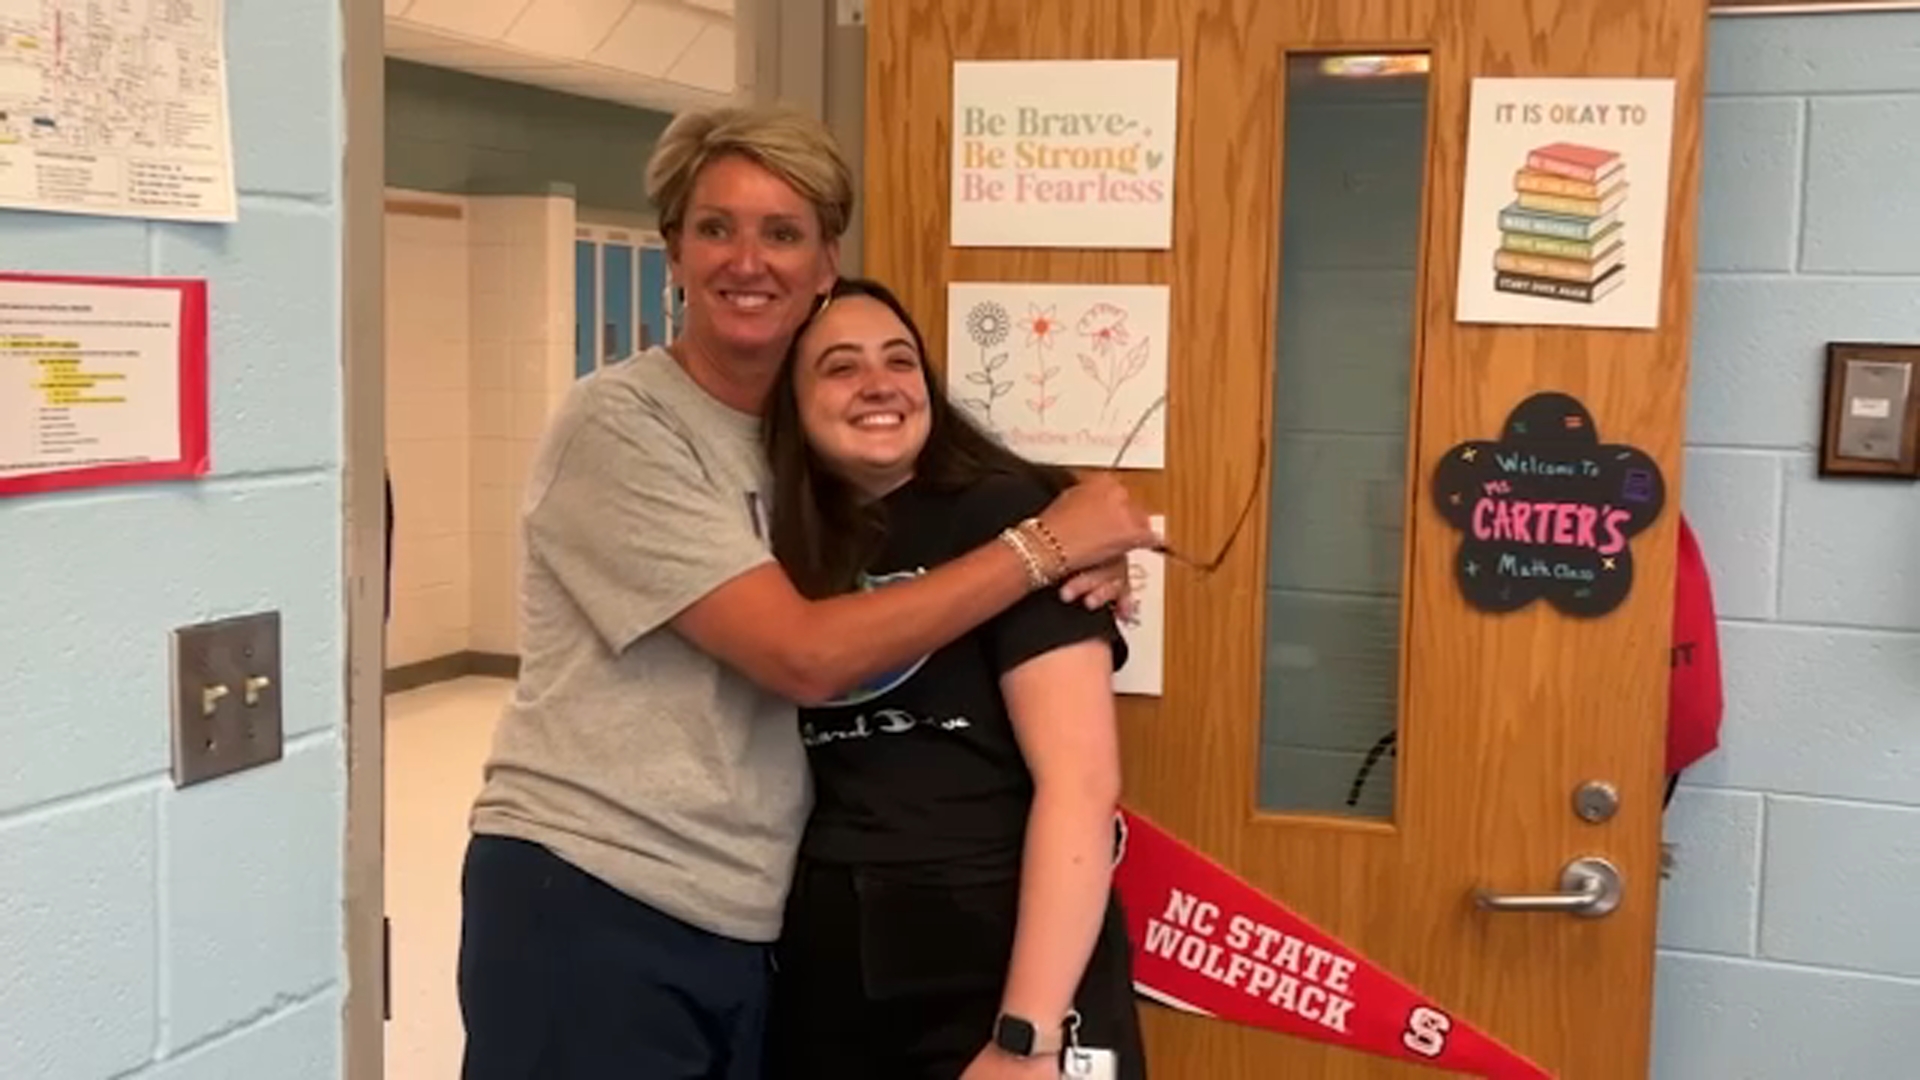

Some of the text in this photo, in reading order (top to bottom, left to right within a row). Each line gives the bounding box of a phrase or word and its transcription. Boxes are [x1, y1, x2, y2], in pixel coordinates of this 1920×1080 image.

[963, 106, 1132, 137] Be Brave
[1495, 104, 1646, 124] IT IS OKAY TO
[963, 140, 1138, 174] Be Strong
[962, 173, 1164, 203] Be Fearless
[1494, 451, 1599, 477] Welcome To
[1472, 497, 1632, 555] CARTER'S
[1498, 553, 1552, 577] Math
[1163, 888, 1357, 995] NC STATE
[1143, 918, 1356, 1034] WOLFPACK
